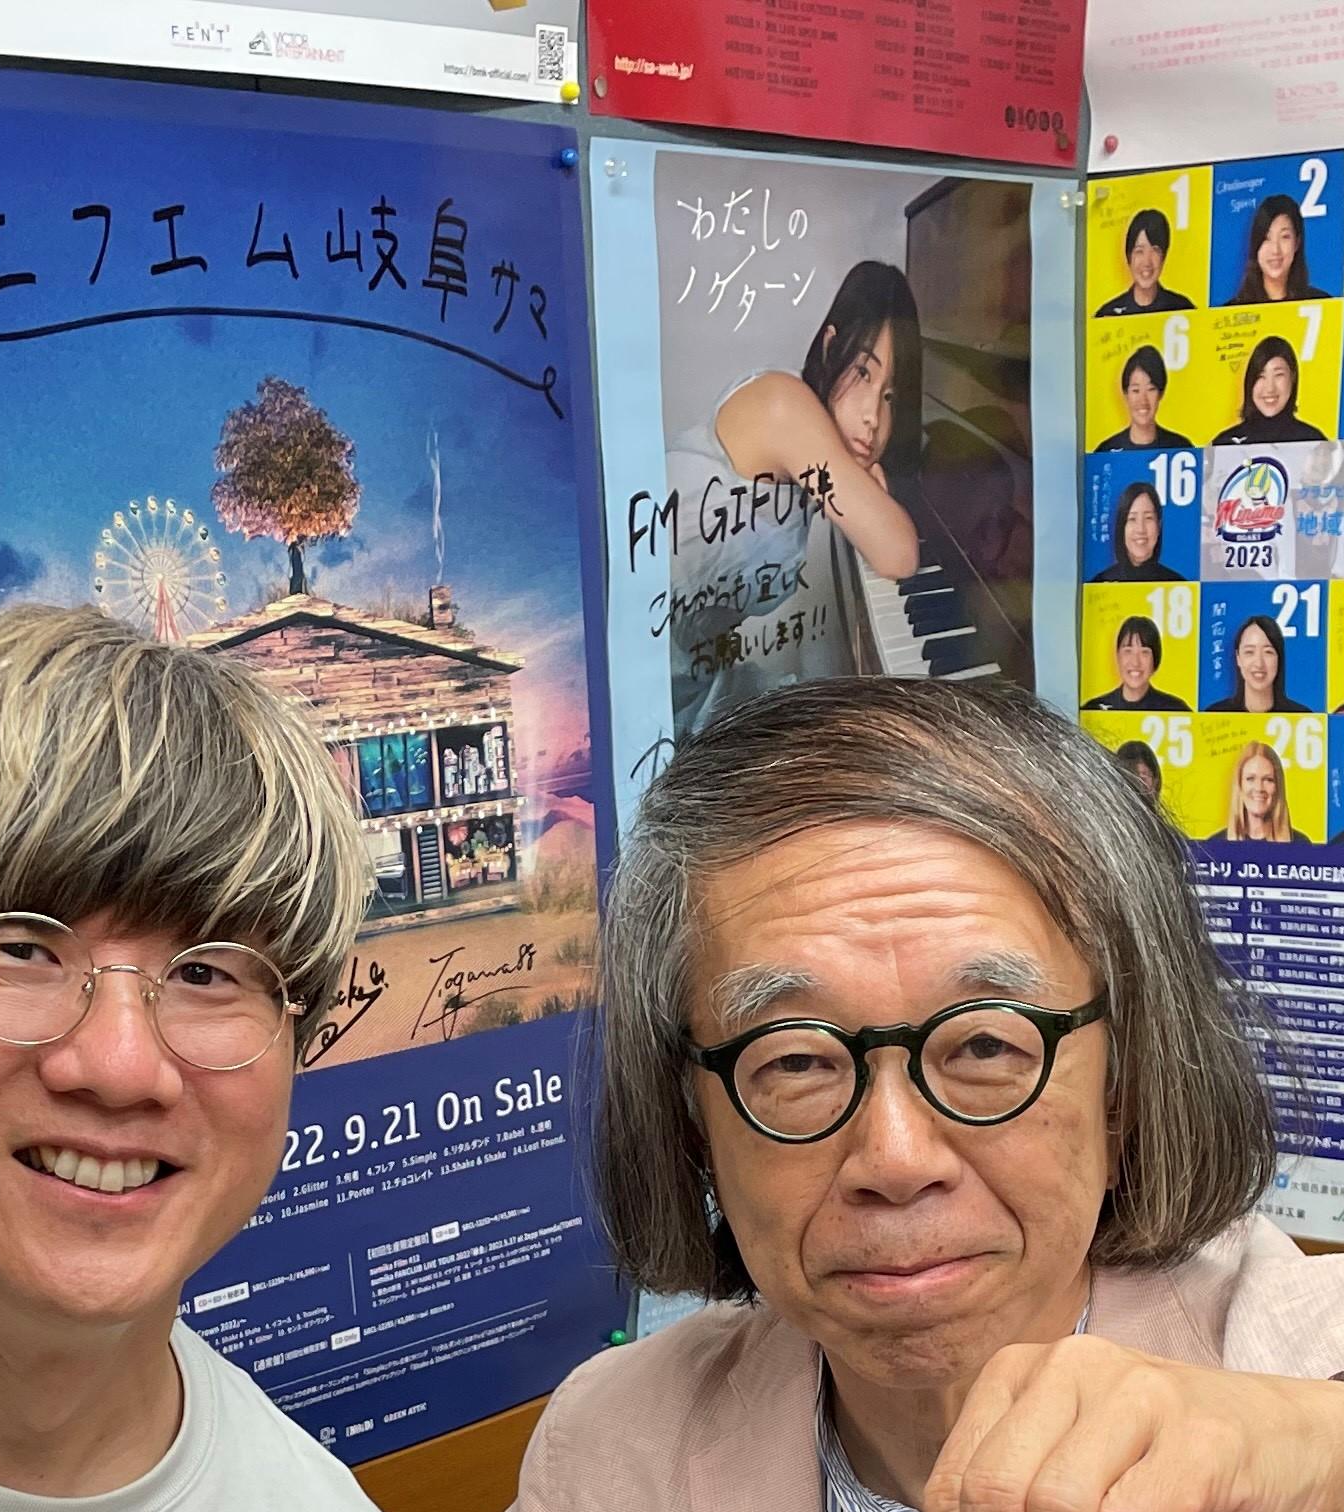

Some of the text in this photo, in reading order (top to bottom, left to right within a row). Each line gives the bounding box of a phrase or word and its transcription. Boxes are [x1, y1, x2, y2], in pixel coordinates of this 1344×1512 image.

[1170, 174, 1190, 230] 1
[1299, 158, 1328, 218] 2
[676, 188, 808, 251] わたしの
[1163, 314, 1190, 372] 6
[1298, 305, 1323, 362] 7
[1148, 451, 1198, 508] 16
[627, 488, 679, 574] FM
[1223, 545, 1274, 569] 2023
[1147, 586, 1193, 640] 18
[1271, 583, 1321, 638] 21
[1141, 715, 1194, 768] 25
[1265, 716, 1325, 772] 26
[1237, 863, 1264, 880] JD.
[436, 1092, 484, 1131] On
[494, 1068, 564, 1118] Sale
[402, 1150, 438, 1169] 5.Simple
